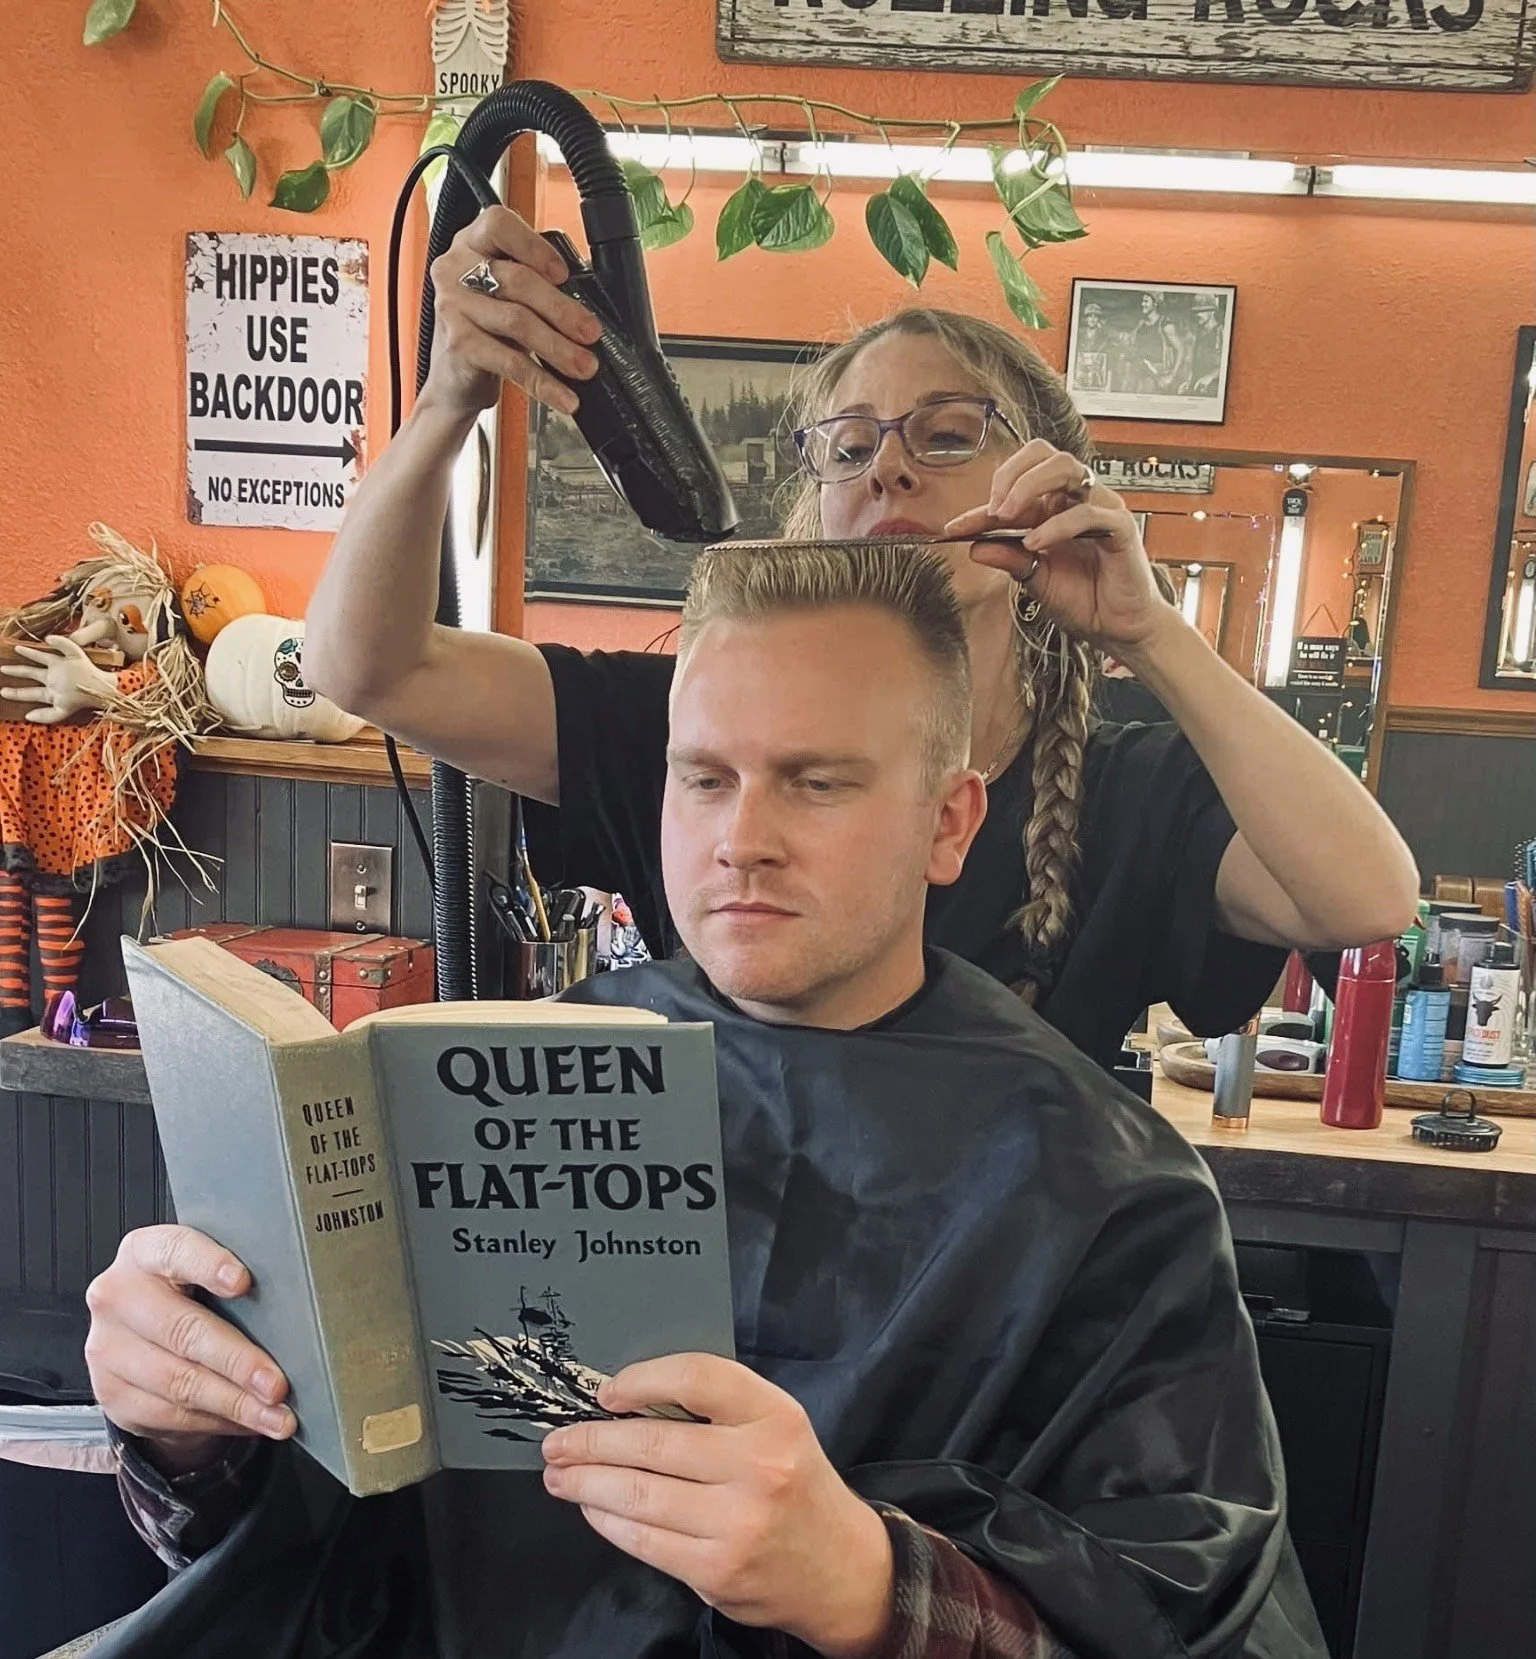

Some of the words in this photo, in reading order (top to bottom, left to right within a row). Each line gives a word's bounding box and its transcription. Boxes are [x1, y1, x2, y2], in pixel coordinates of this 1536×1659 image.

[439, 72, 500, 94] SPOOKY
[215, 253, 340, 305] HIPPIES
[247, 315, 308, 363] USE
[189, 372, 365, 425] BACKDOOR
[208, 476, 232, 502] NO
[238, 478, 345, 508] EXCEPTIONS
[437, 1045, 665, 1107] QUEEN
[302, 1096, 354, 1127] QUEEN
[310, 1133, 328, 1155] OF
[334, 1126, 361, 1150] THE
[474, 1117, 537, 1151] OF
[550, 1118, 641, 1151] THE
[306, 1153, 376, 1184] FLAT-TOPS
[410, 1162, 718, 1211] FLAT-TOPS
[315, 1200, 384, 1232] JOHNSTON
[452, 1227, 556, 1260] Stanley
[574, 1229, 702, 1263] Johnston
